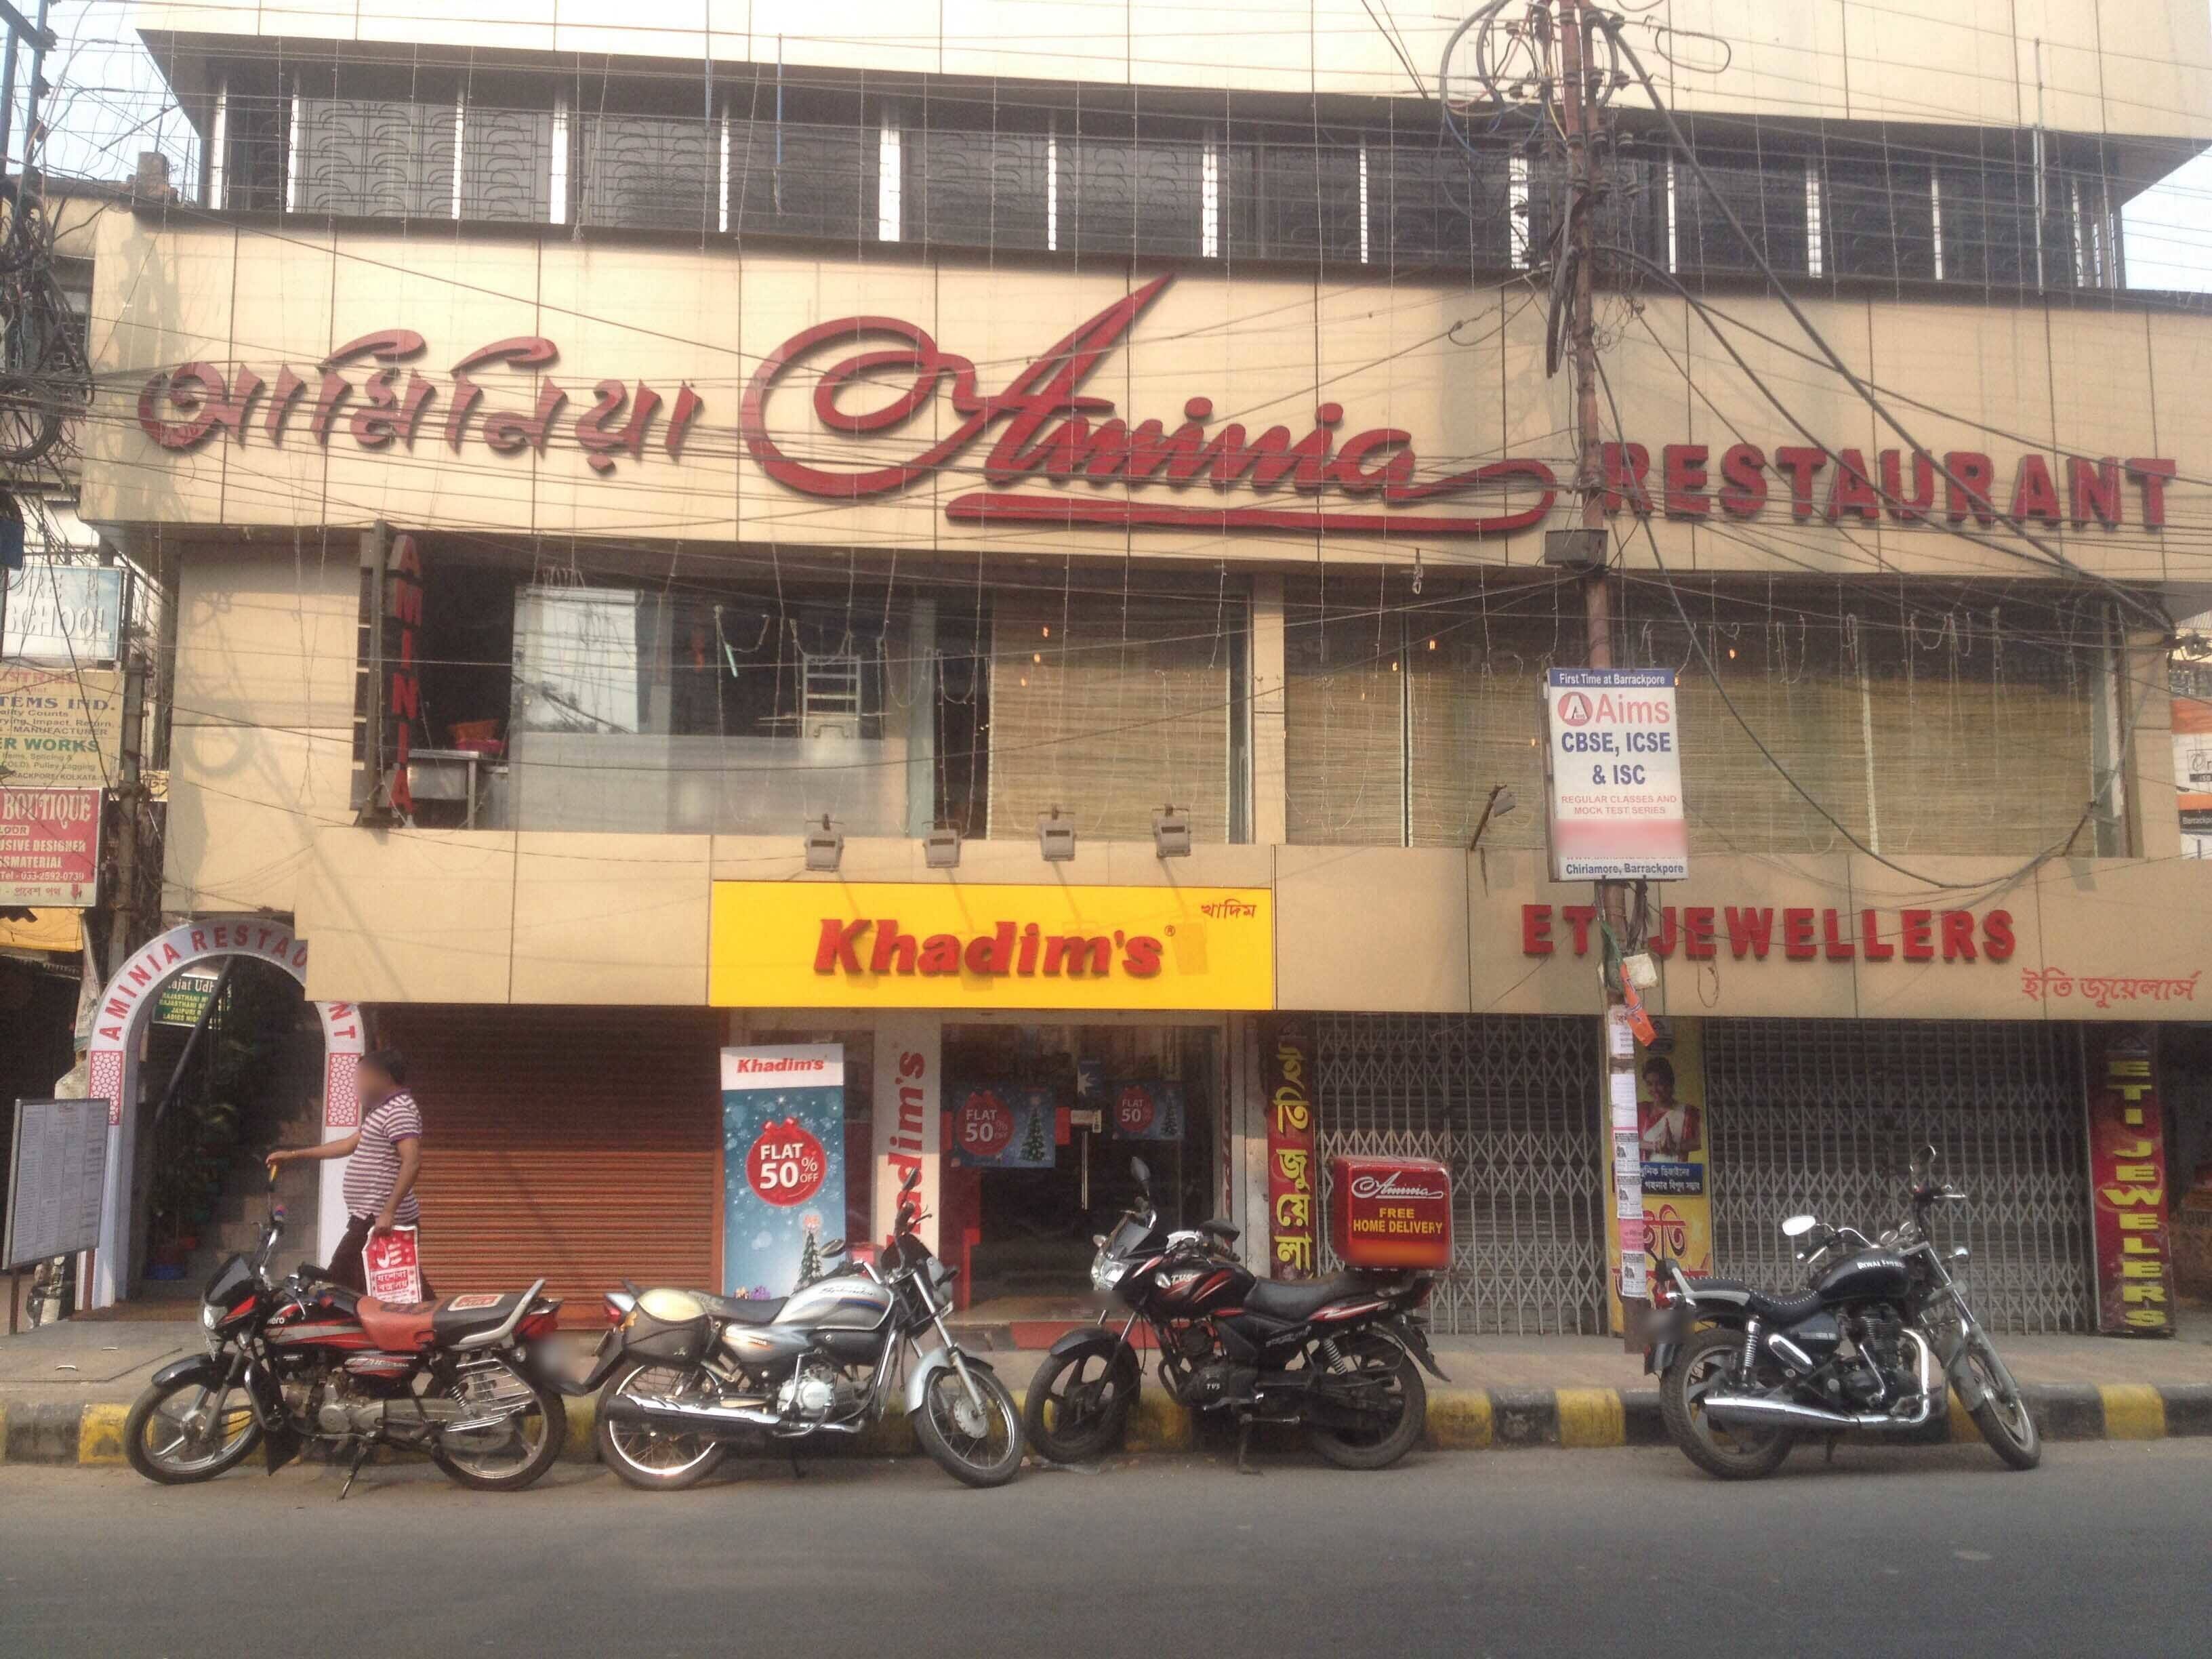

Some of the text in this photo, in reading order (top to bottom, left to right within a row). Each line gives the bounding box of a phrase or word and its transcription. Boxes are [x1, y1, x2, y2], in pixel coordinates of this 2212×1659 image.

[741, 272, 2176, 532] Aminia RESTAURANT
[1559, 673, 1665, 687] First Time at Barrackpore
[1595, 693, 1671, 724] Aims
[24, 738, 98, 753] WORKS
[1561, 732, 1671, 756] CBSE, ICSE
[1593, 764, 1645, 785] & ISC
[1561, 796, 1607, 804] REGULAR
[1657, 795, 1677, 803] AND
[2, 792, 91, 830] BOUTIQUE
[1632, 806, 1666, 815] SERIES
[33, 840, 86, 853] DESIGNER
[1566, 863, 1684, 876] Chiriamore, Barrackpore
[1201, 898, 1256, 919] খাদিম
[1521, 903, 2016, 963] ET JEWELLERS
[814, 918, 1164, 979] Khadim's
[99, 942, 182, 1042] AMINIA
[168, 979, 191, 993] ajat
[2021, 966, 2202, 1008] ইতি জুয়েলার্স
[737, 1058, 825, 1073] Khadim's
[1122, 1099, 1144, 1107] FLAT
[966, 1109, 998, 1120] FLAT
[1122, 1108, 1141, 1122] 50
[965, 1122, 994, 1143] 50
[760, 1143, 803, 1160] FLAT
[759, 1162, 798, 1189] 50
[800, 1172, 819, 1183] OFF
[1351, 1170, 1444, 1200] Aminia
[1379, 1208, 1415, 1219] FREE
[1353, 1219, 1443, 1234] HOME DELIVERY
